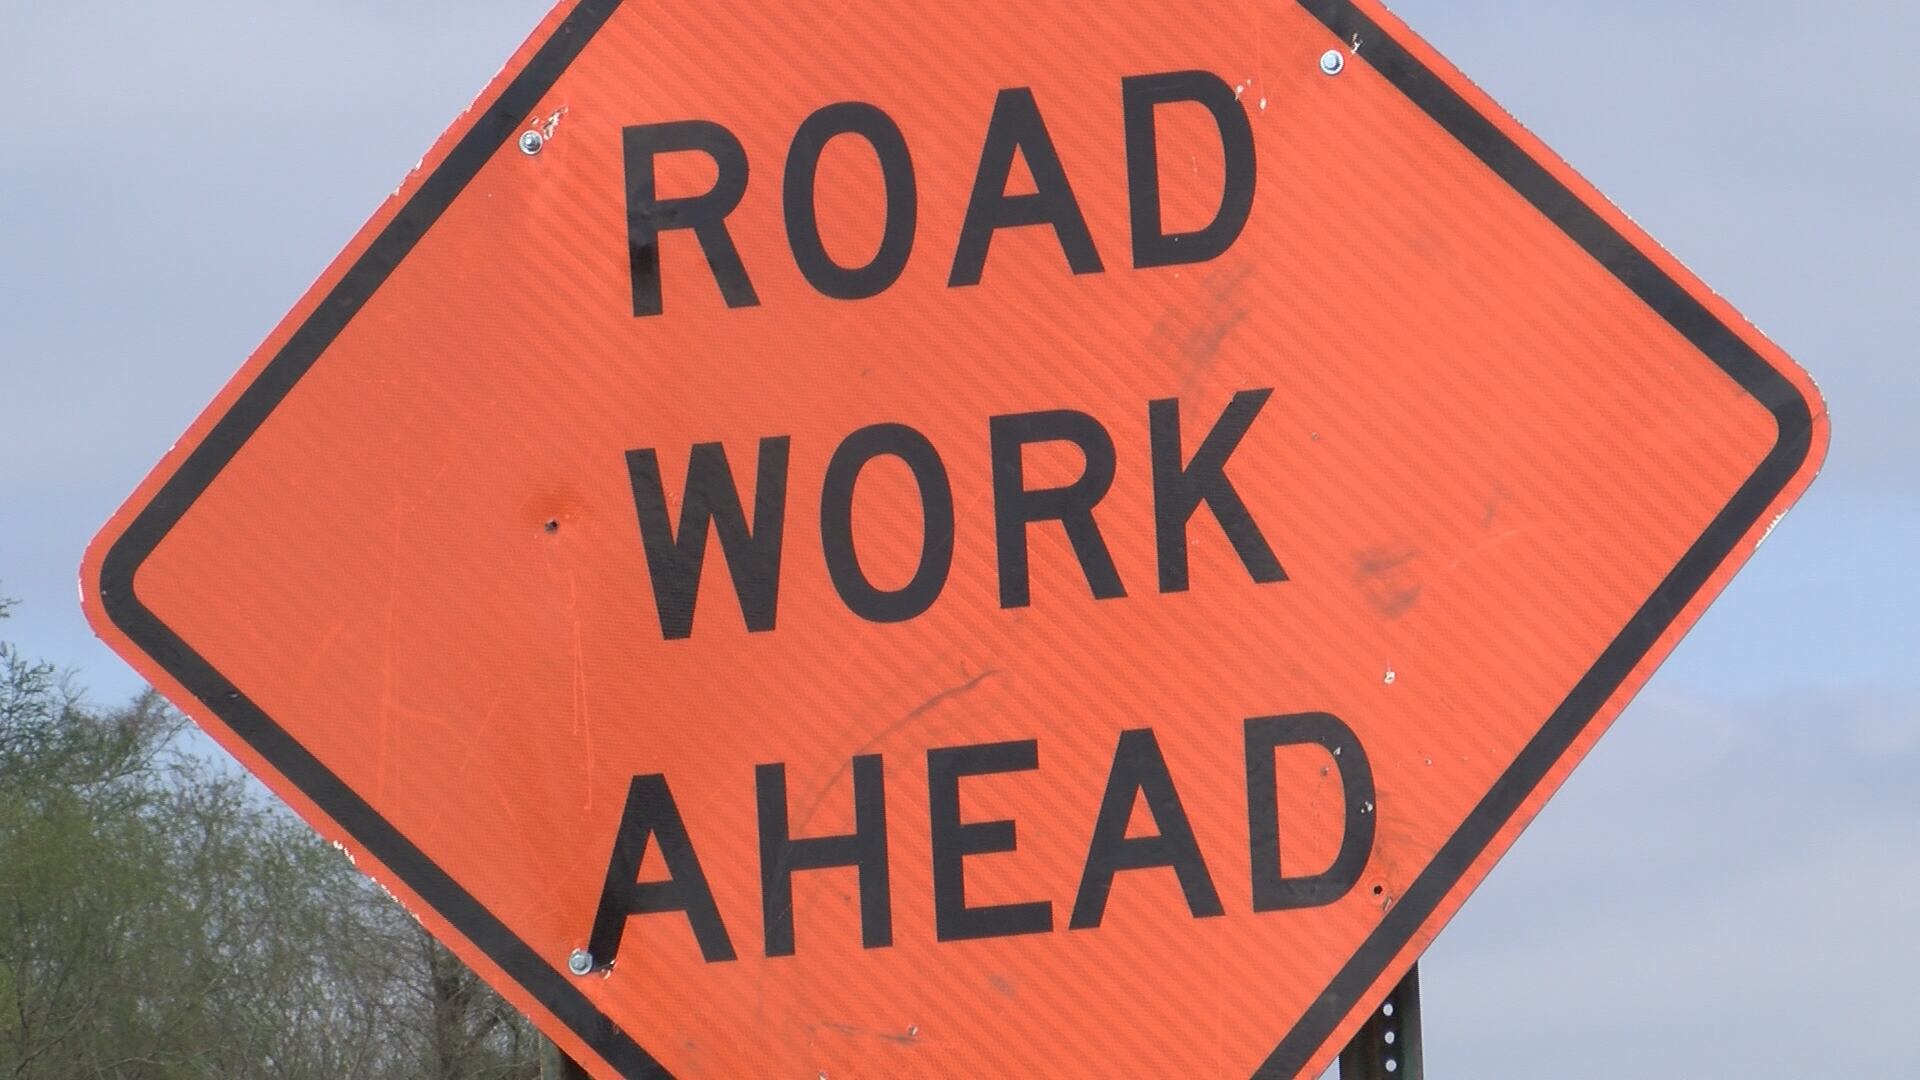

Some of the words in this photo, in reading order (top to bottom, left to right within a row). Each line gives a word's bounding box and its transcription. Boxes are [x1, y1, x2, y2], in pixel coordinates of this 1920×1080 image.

[623, 71, 1256, 317] ROAD
[626, 389, 1287, 640] WORK
[587, 713, 1376, 974] AHEAD
